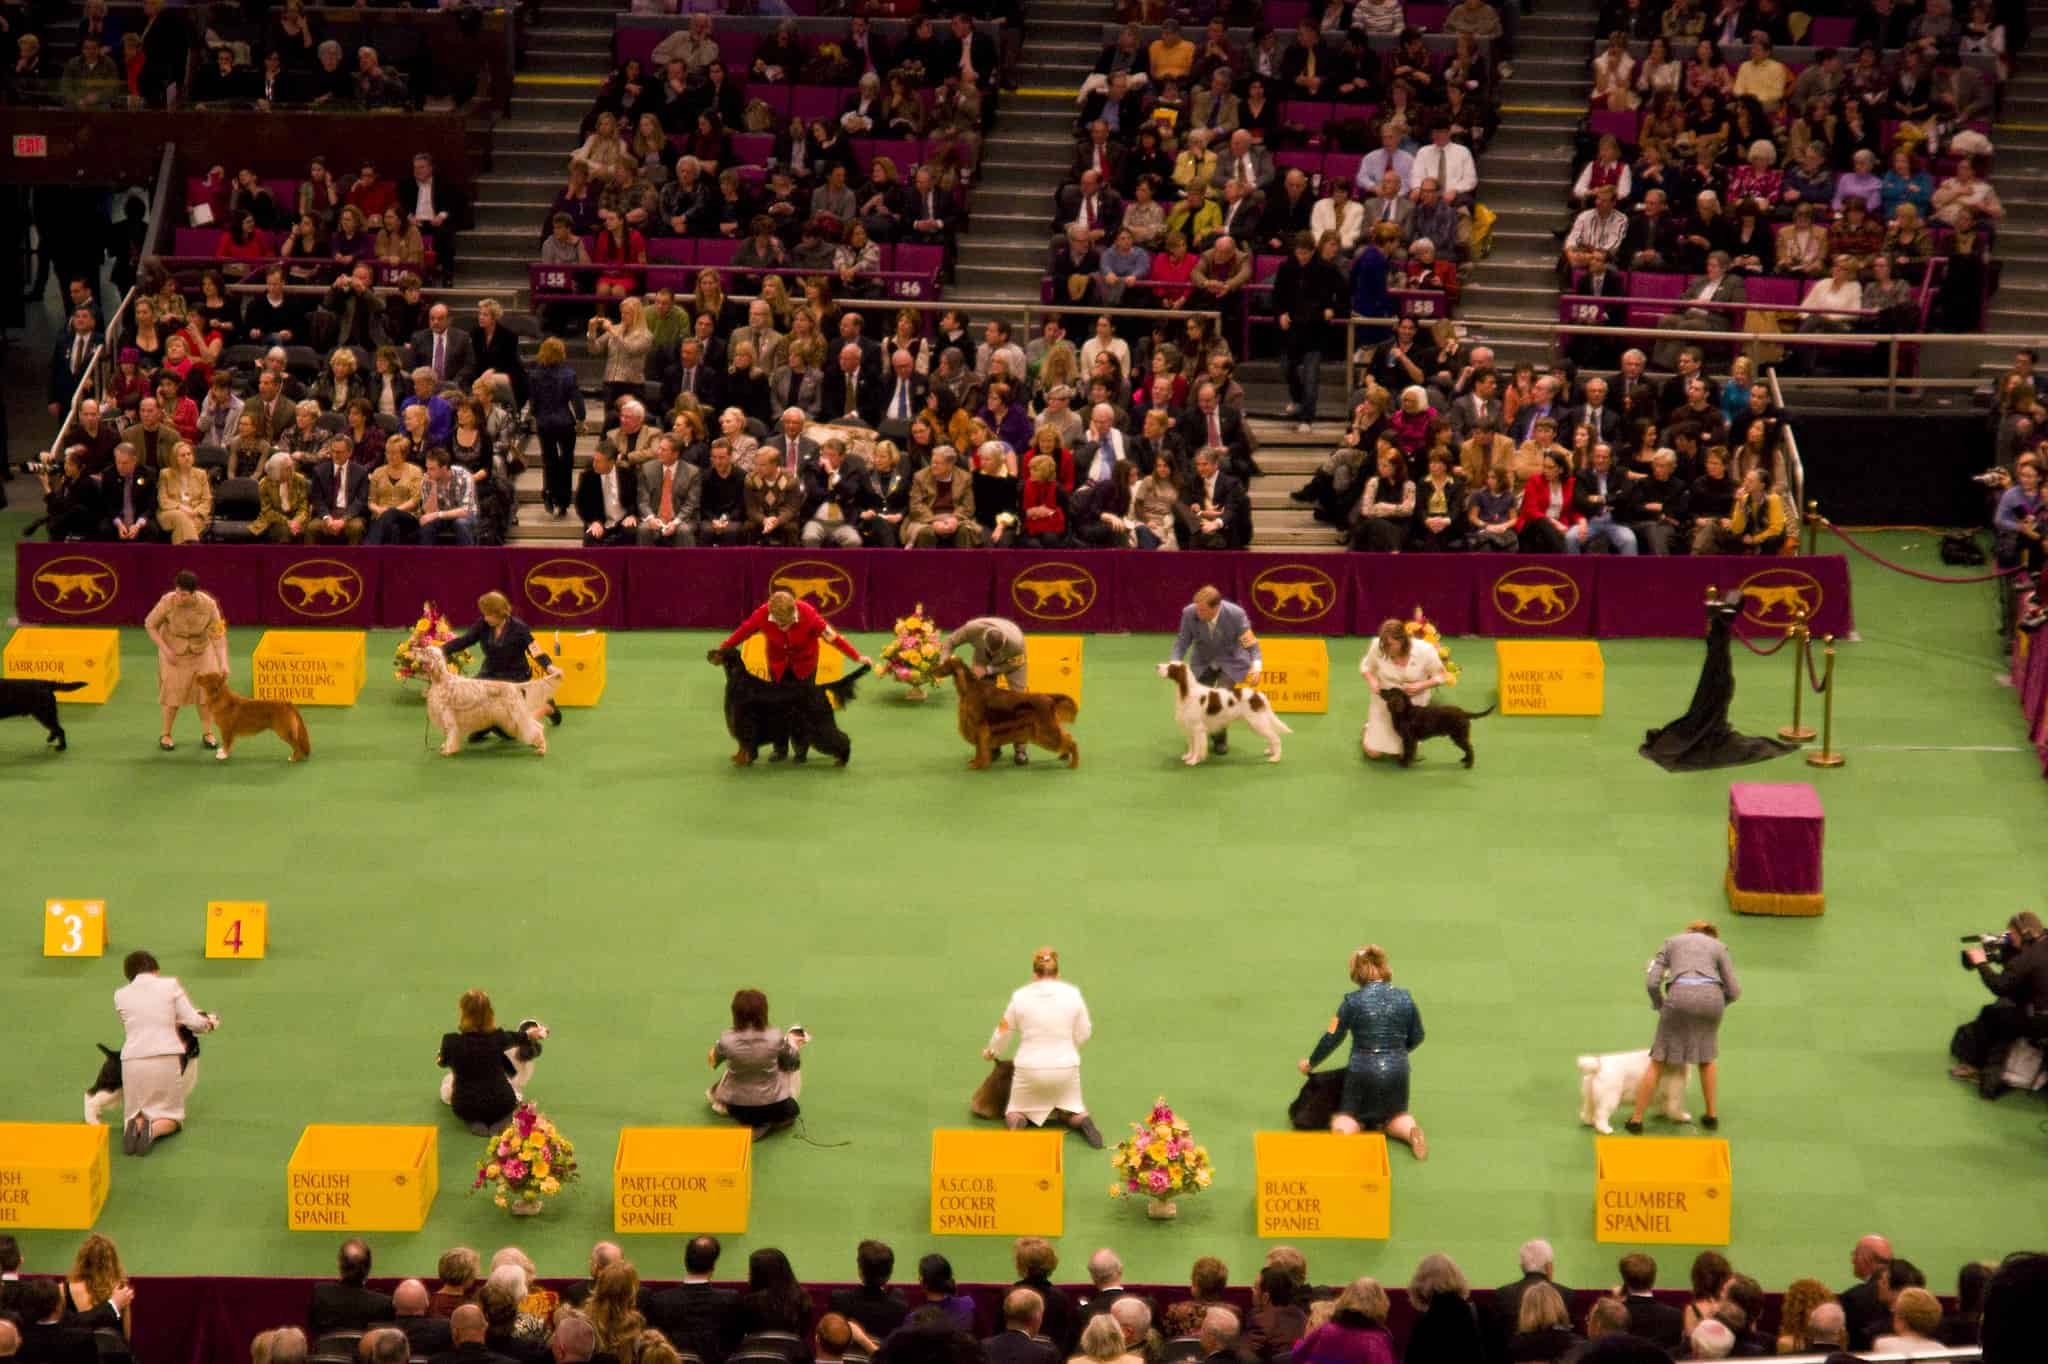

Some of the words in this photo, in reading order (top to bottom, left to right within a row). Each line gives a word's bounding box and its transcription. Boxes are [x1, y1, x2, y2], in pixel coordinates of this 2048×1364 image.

[547, 272, 565, 288] 55
[901, 281, 921, 297] 56
[1414, 300, 1434, 315] 58
[1579, 304, 1599, 320] 59
[8, 659, 65, 674] LABRADOR
[257, 660, 288, 673] NOVA
[290, 660, 328, 673] SCOTIA
[258, 674, 288, 686] DUCK
[291, 674, 336, 688] TOLLING
[1507, 671, 1564, 682] AMERICAN
[258, 687, 316, 701] RETRIEVER
[1293, 691, 1321, 703] WHITE
[1507, 684, 1544, 697] WATER
[1507, 696, 1548, 710] SPANIEL
[62, 914, 82, 953] 3
[223, 919, 244, 955] 4
[294, 1174, 350, 1189] ENGLISH
[620, 1176, 708, 1193] PARTI-COLOR
[1264, 1182, 1308, 1196] BLACK
[295, 1192, 352, 1208] COCKER
[621, 1194, 677, 1209] COCKER
[940, 1196, 996, 1212] COCKER
[1264, 1199, 1321, 1213] COCKER
[1603, 1190, 1688, 1213] CLUMBER
[294, 1208, 350, 1225] SPANIEL
[621, 1210, 674, 1227] SPANIEL
[939, 1213, 998, 1230] SPANIEL
[1264, 1215, 1320, 1232] SPANIEL
[1604, 1210, 1672, 1233] SPANIEL
